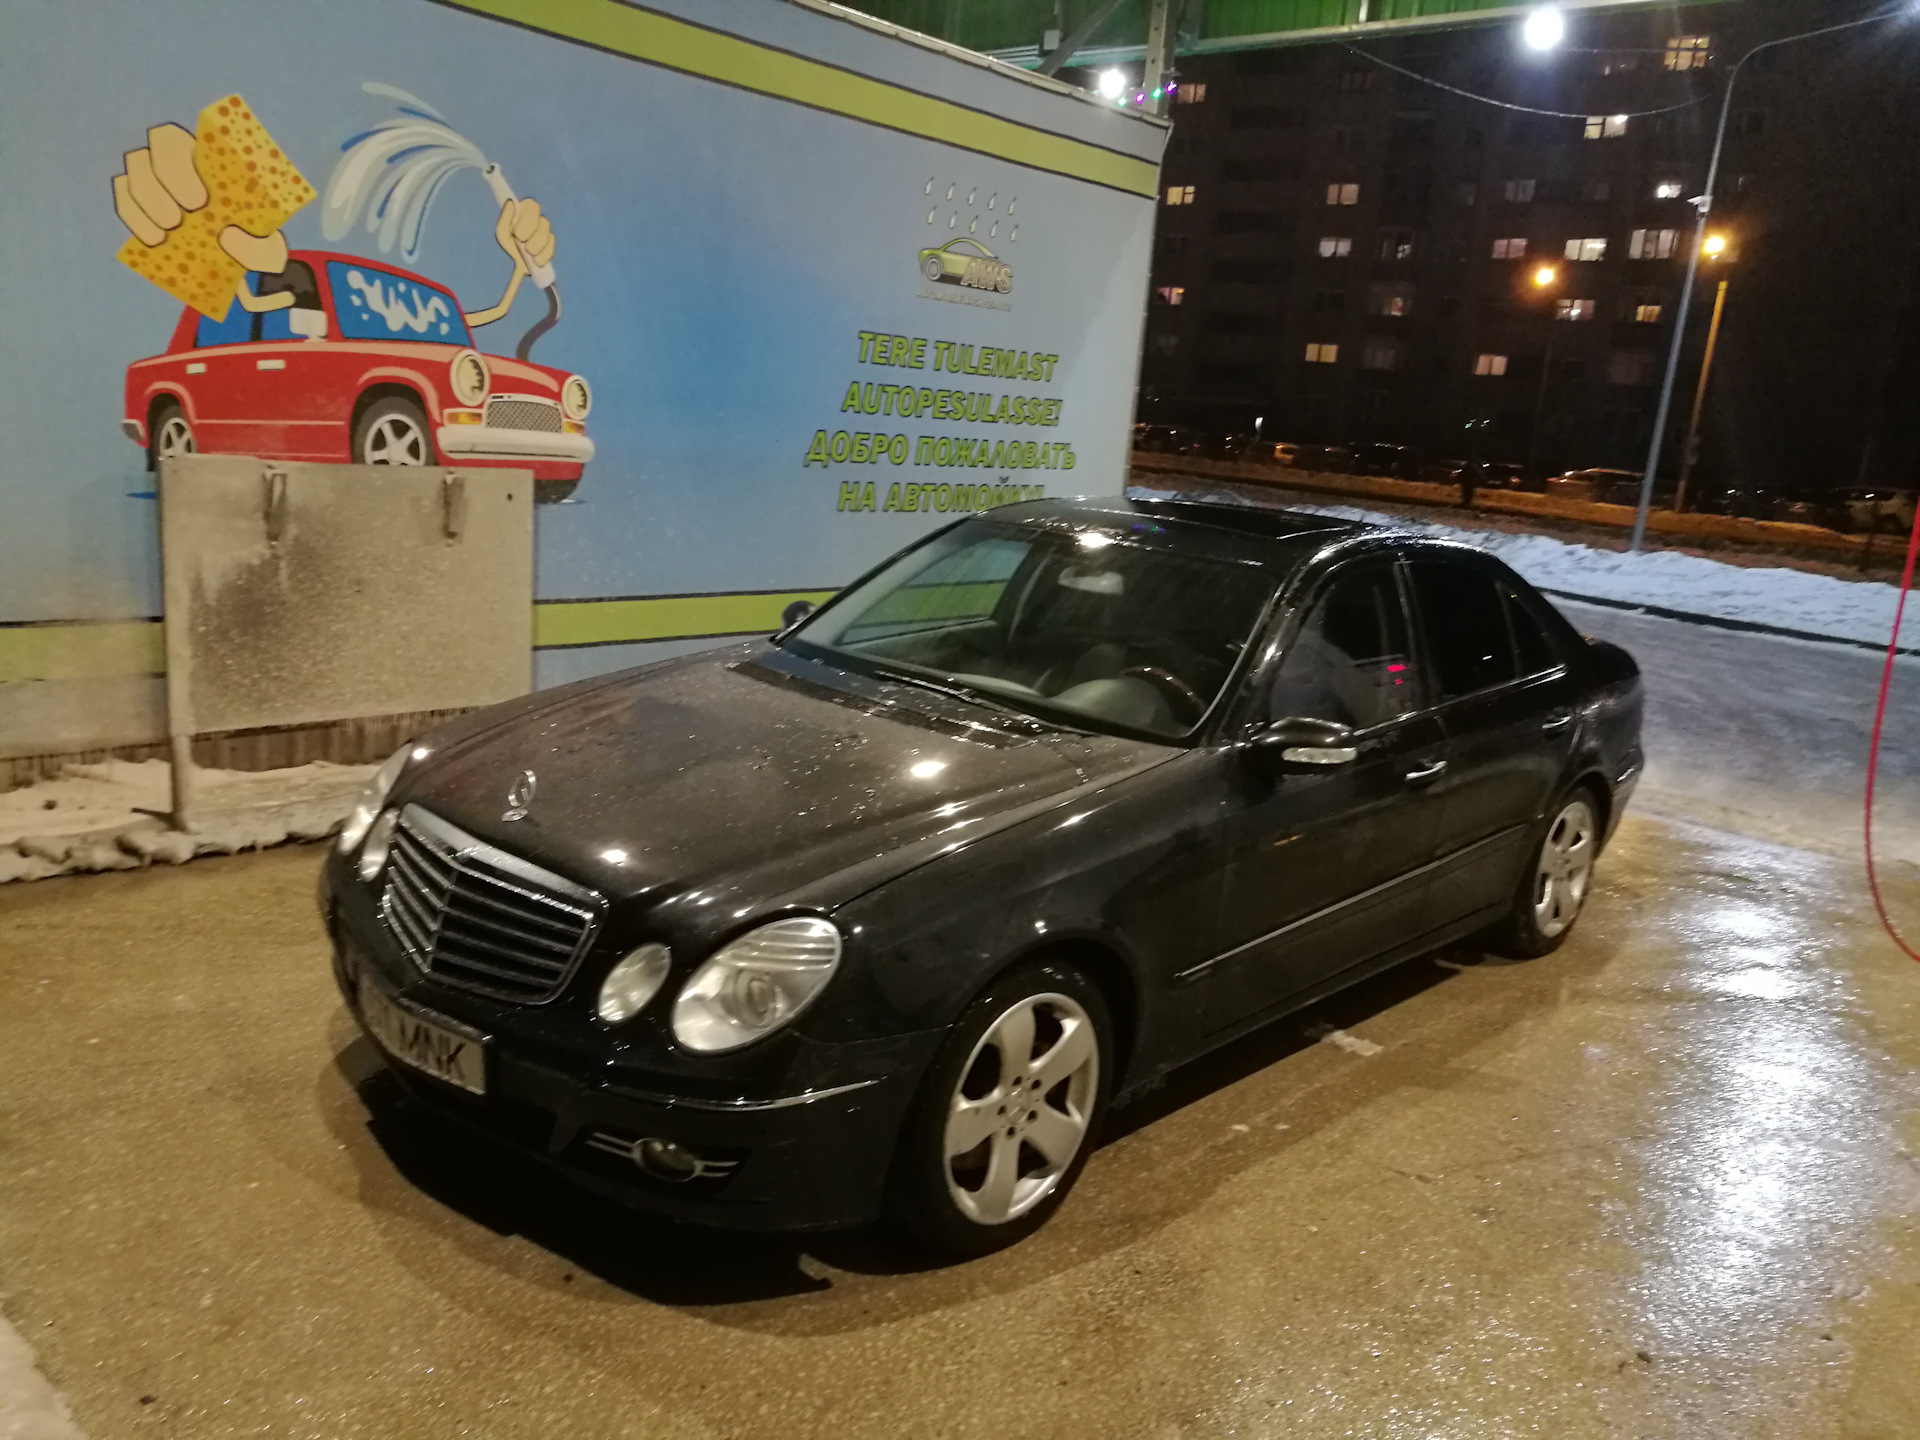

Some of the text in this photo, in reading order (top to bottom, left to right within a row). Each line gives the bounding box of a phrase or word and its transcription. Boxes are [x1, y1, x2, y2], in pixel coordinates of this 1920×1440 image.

[858, 331, 1058, 382] TERE TULEMAST
[840, 381, 1063, 426] AUTOPESULASSE!
[804, 430, 1076, 470] ДОБРО ПОЖАЛОВАТЬ
[837, 480, 875, 513] НА
